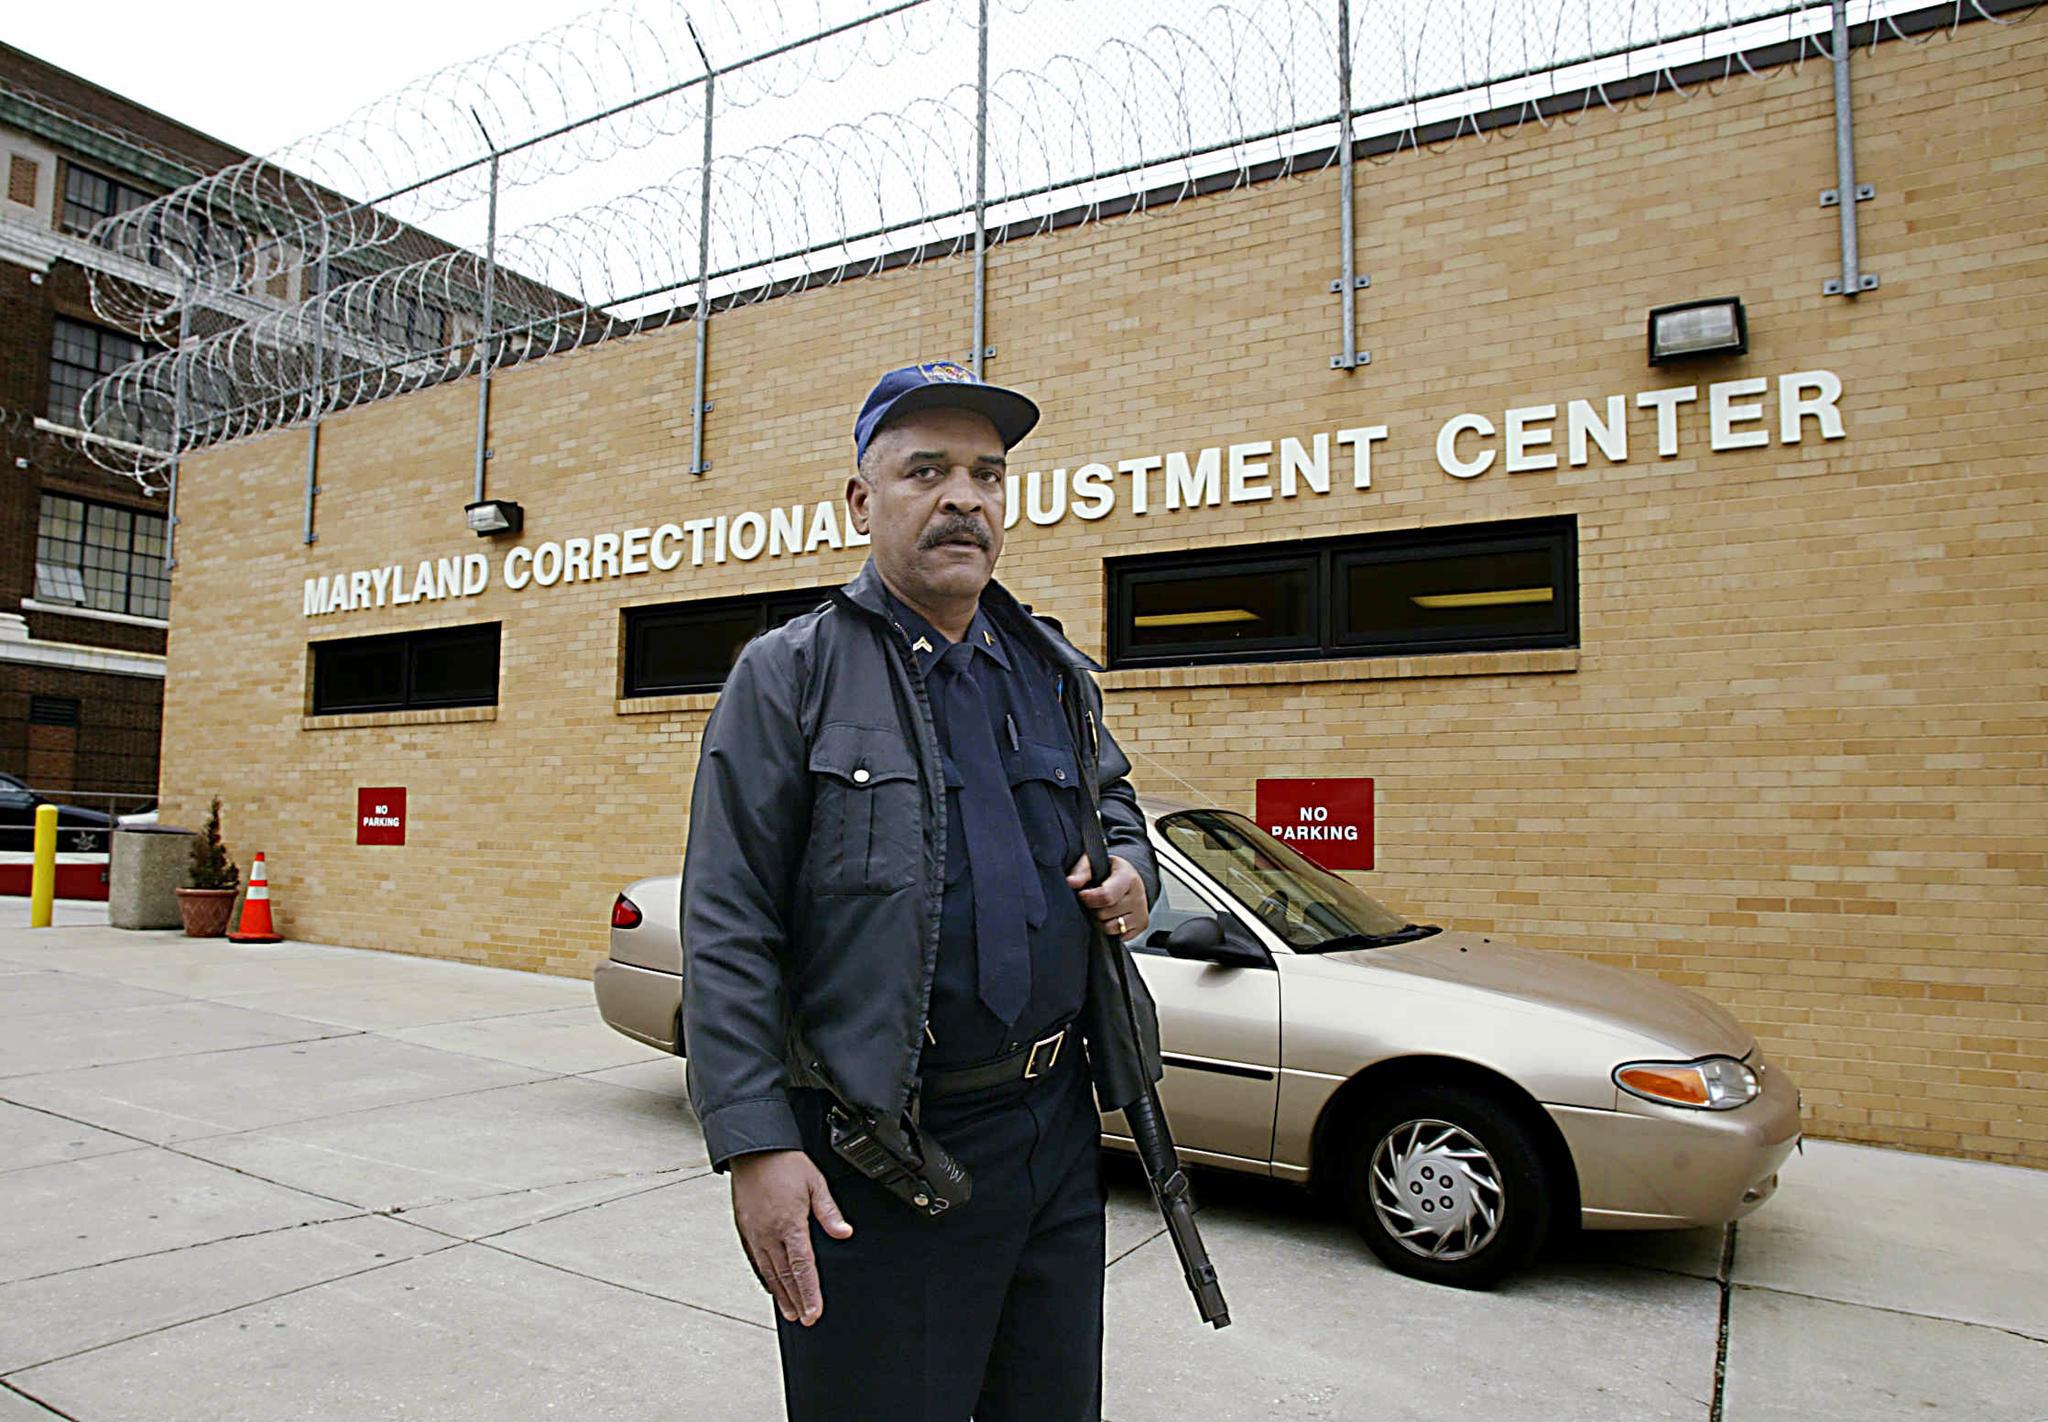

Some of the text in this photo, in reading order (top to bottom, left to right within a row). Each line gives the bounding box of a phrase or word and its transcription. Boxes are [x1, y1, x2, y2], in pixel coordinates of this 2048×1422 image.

[303, 369, 1847, 616] MARYLAND CORRECTIONAL JUSTMENT CENTER
[375, 805, 388, 814] NO
[1299, 806, 1328, 822] NO
[363, 817, 399, 827] PARKING
[1271, 825, 1359, 841] PARKING
